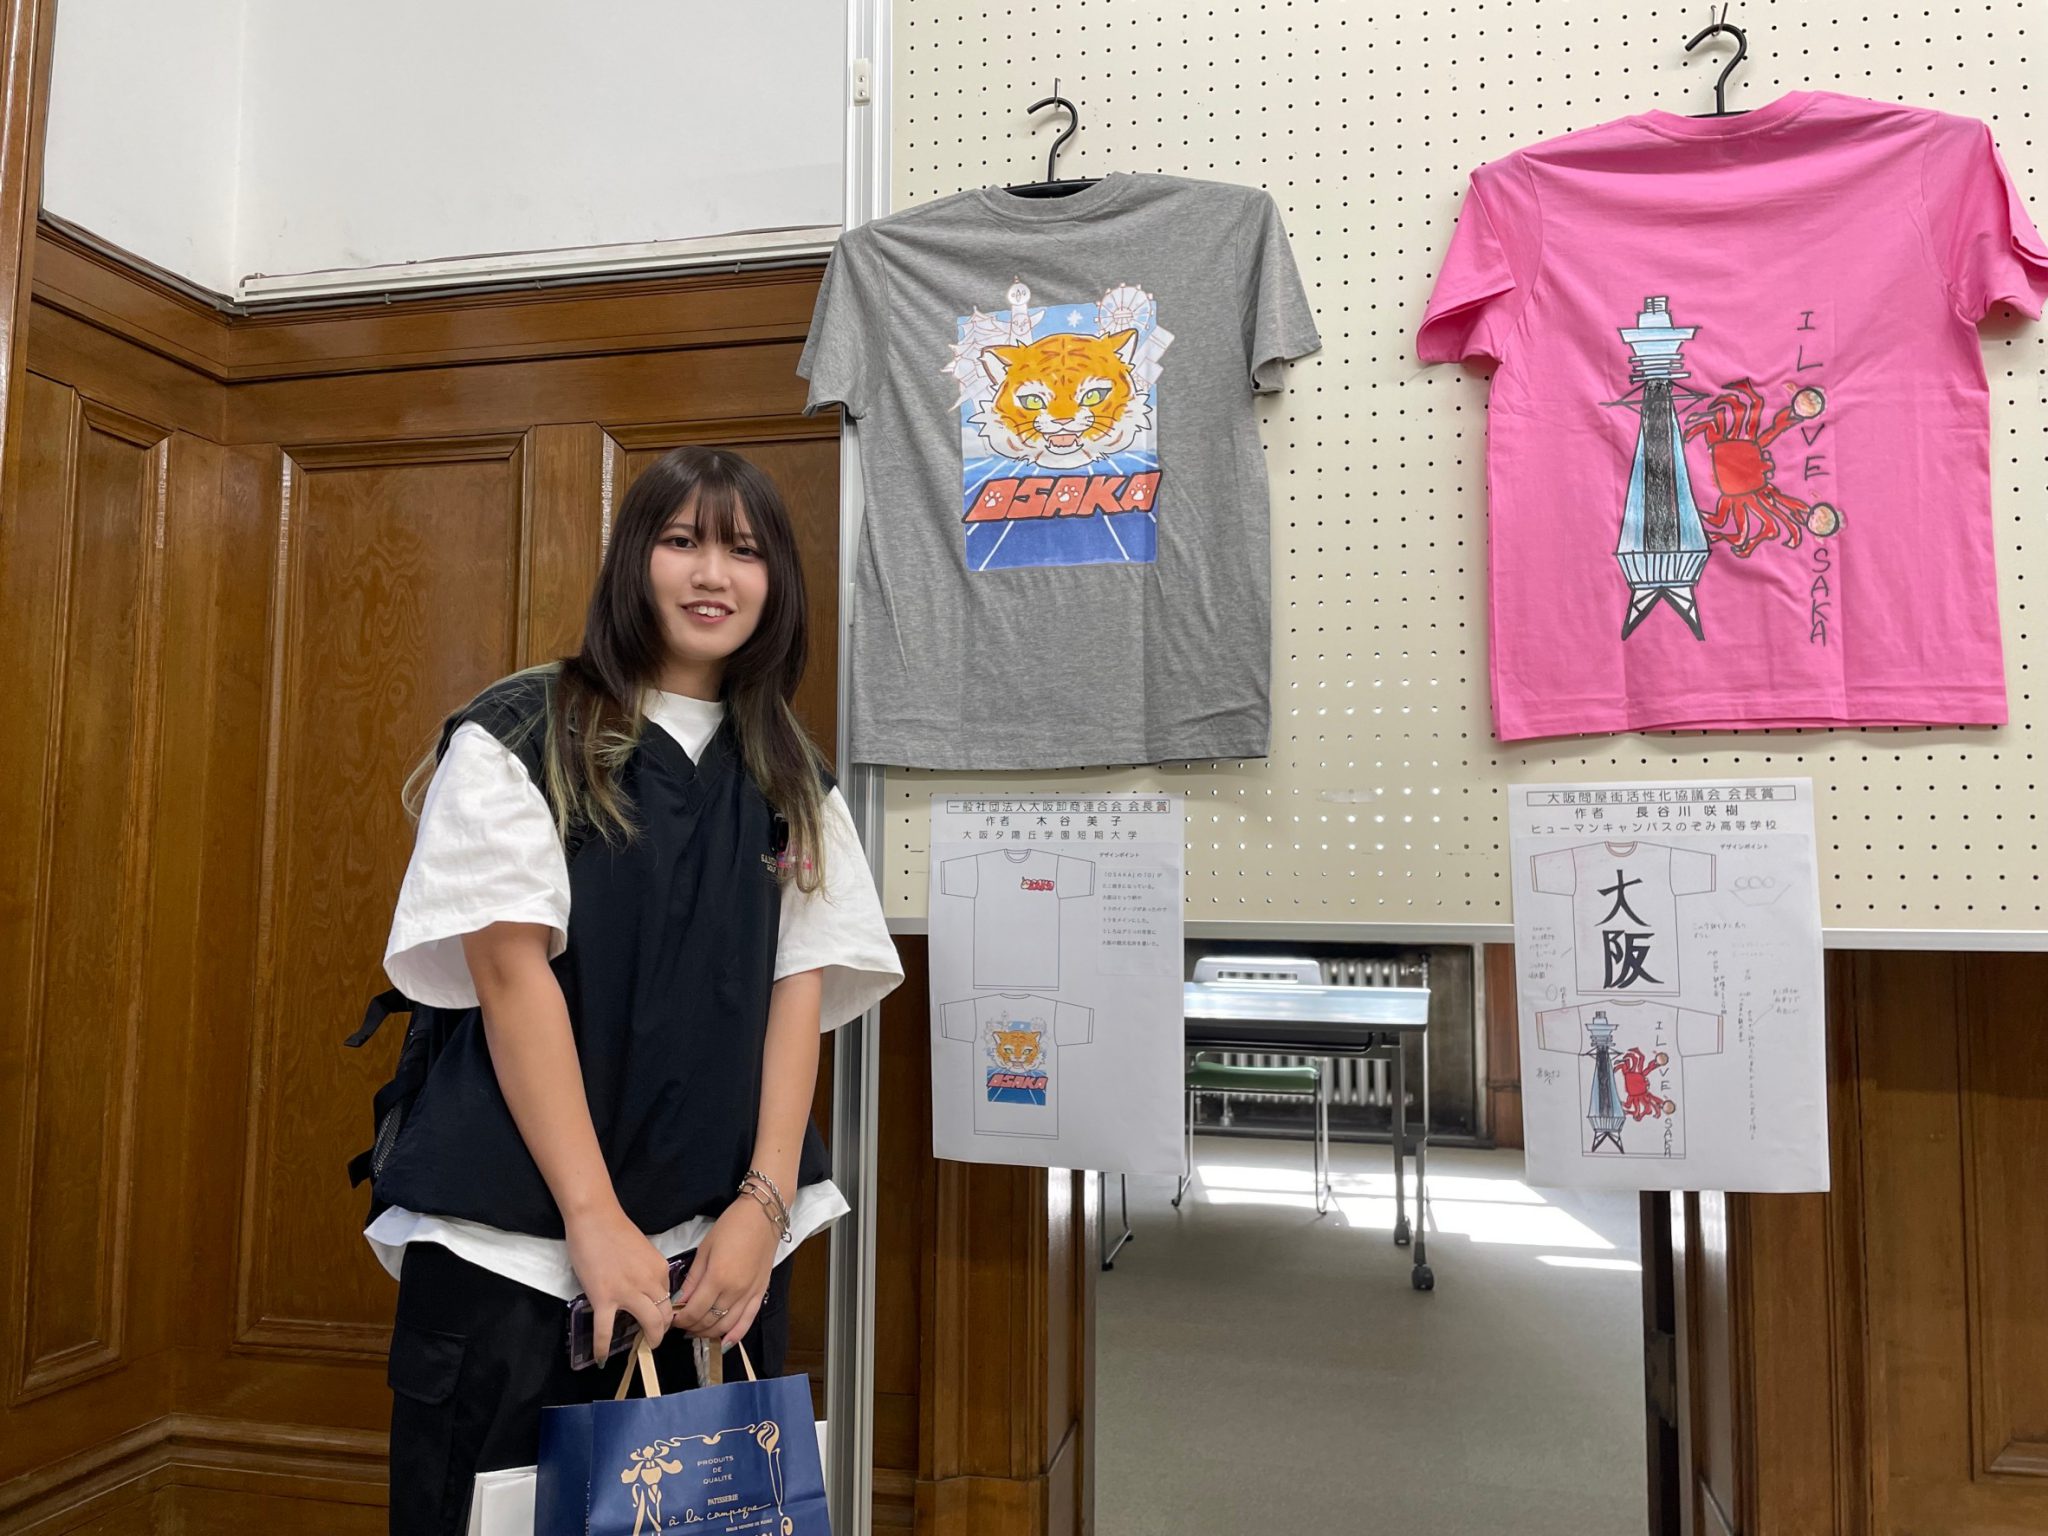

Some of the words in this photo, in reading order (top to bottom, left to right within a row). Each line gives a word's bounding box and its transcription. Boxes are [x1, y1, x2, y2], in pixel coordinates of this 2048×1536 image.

[1797, 311, 1815, 331] I
[961, 469, 1164, 524] OSAKA
[1729, 786, 1775, 801] 会長賞
[949, 800, 1122, 812] 一般社団法人大阪卸商連合会
[1128, 800, 1168, 812] 会長賞
[1575, 807, 1604, 820] 作者
[985, 815, 1010, 827] 作者
[1594, 869, 1665, 990] 大阪
[1654, 1020, 1665, 1030] I
[986, 1073, 1049, 1091] OSAKA
[696, 1455, 734, 1467] PRODUITS
[712, 1466, 722, 1474] DE
[668, 1515, 680, 1527] à
[684, 1508, 704, 1524] la
[706, 1503, 771, 1523] campagne
